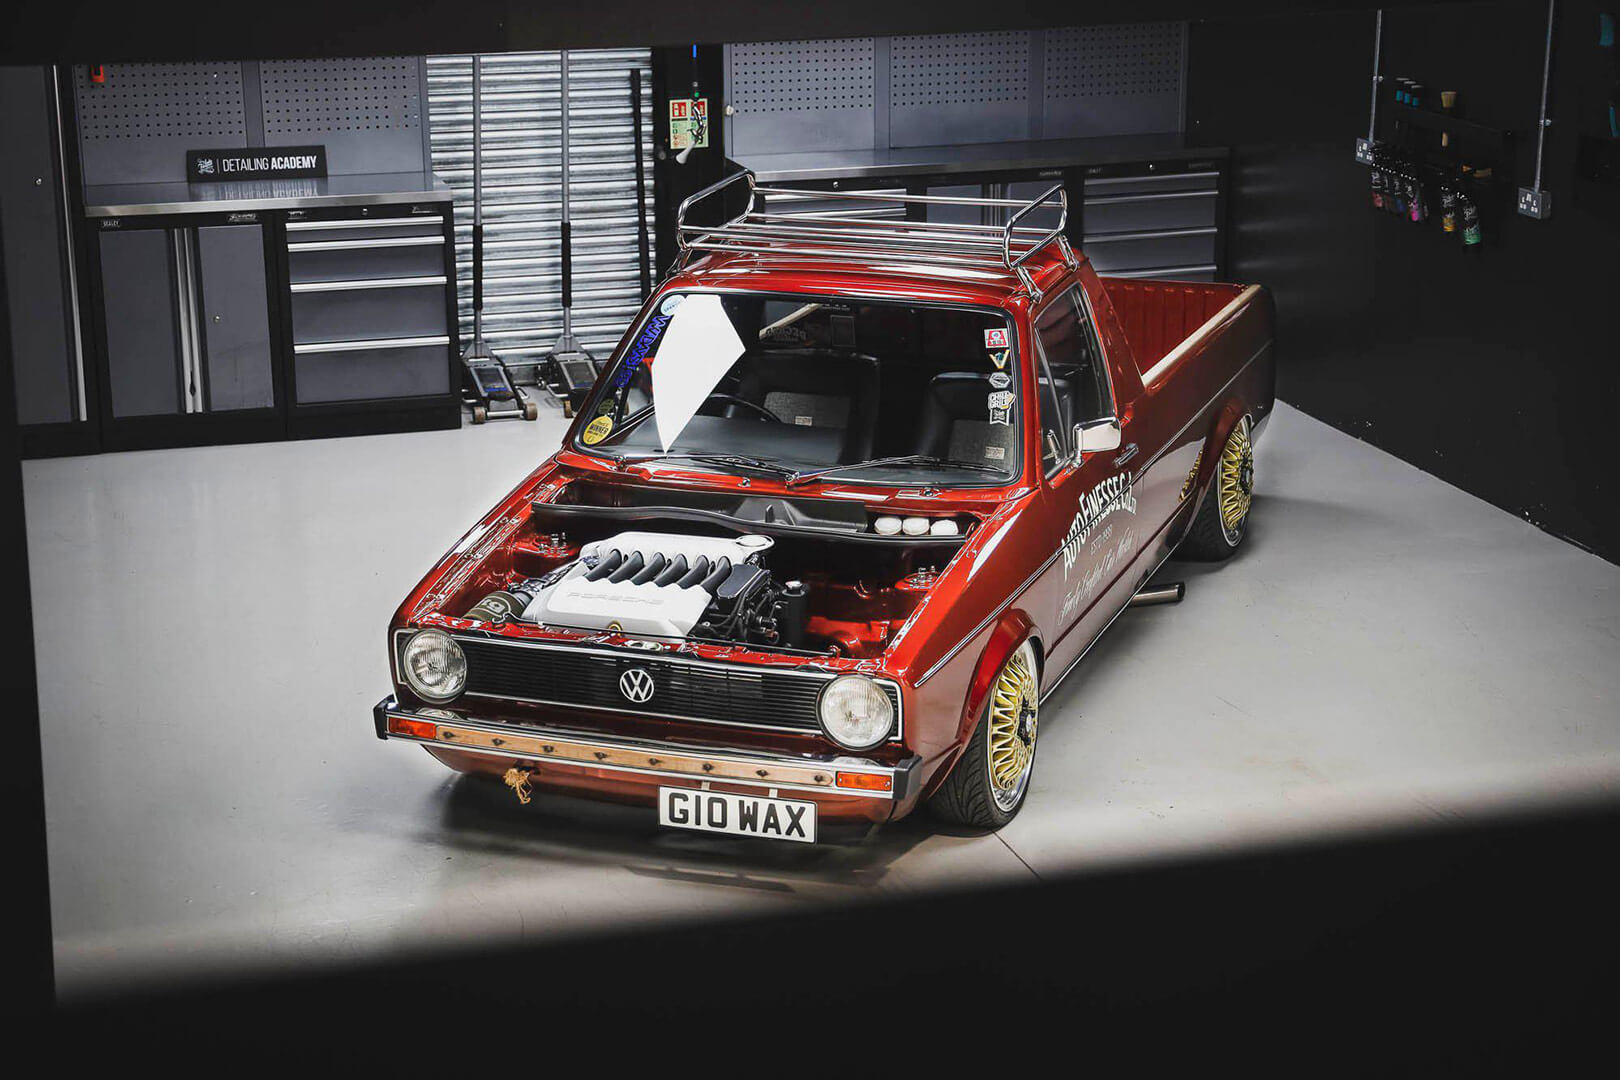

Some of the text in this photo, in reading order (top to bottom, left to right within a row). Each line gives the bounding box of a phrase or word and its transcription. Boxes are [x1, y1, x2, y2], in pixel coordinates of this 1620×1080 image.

[222, 157, 269, 172] DETAILING
[271, 155, 317, 169] ACADEMY
[1061, 512, 1087, 582] AUTO
[1079, 476, 1123, 532] FINESSE
[738, 799, 806, 838] WAX
